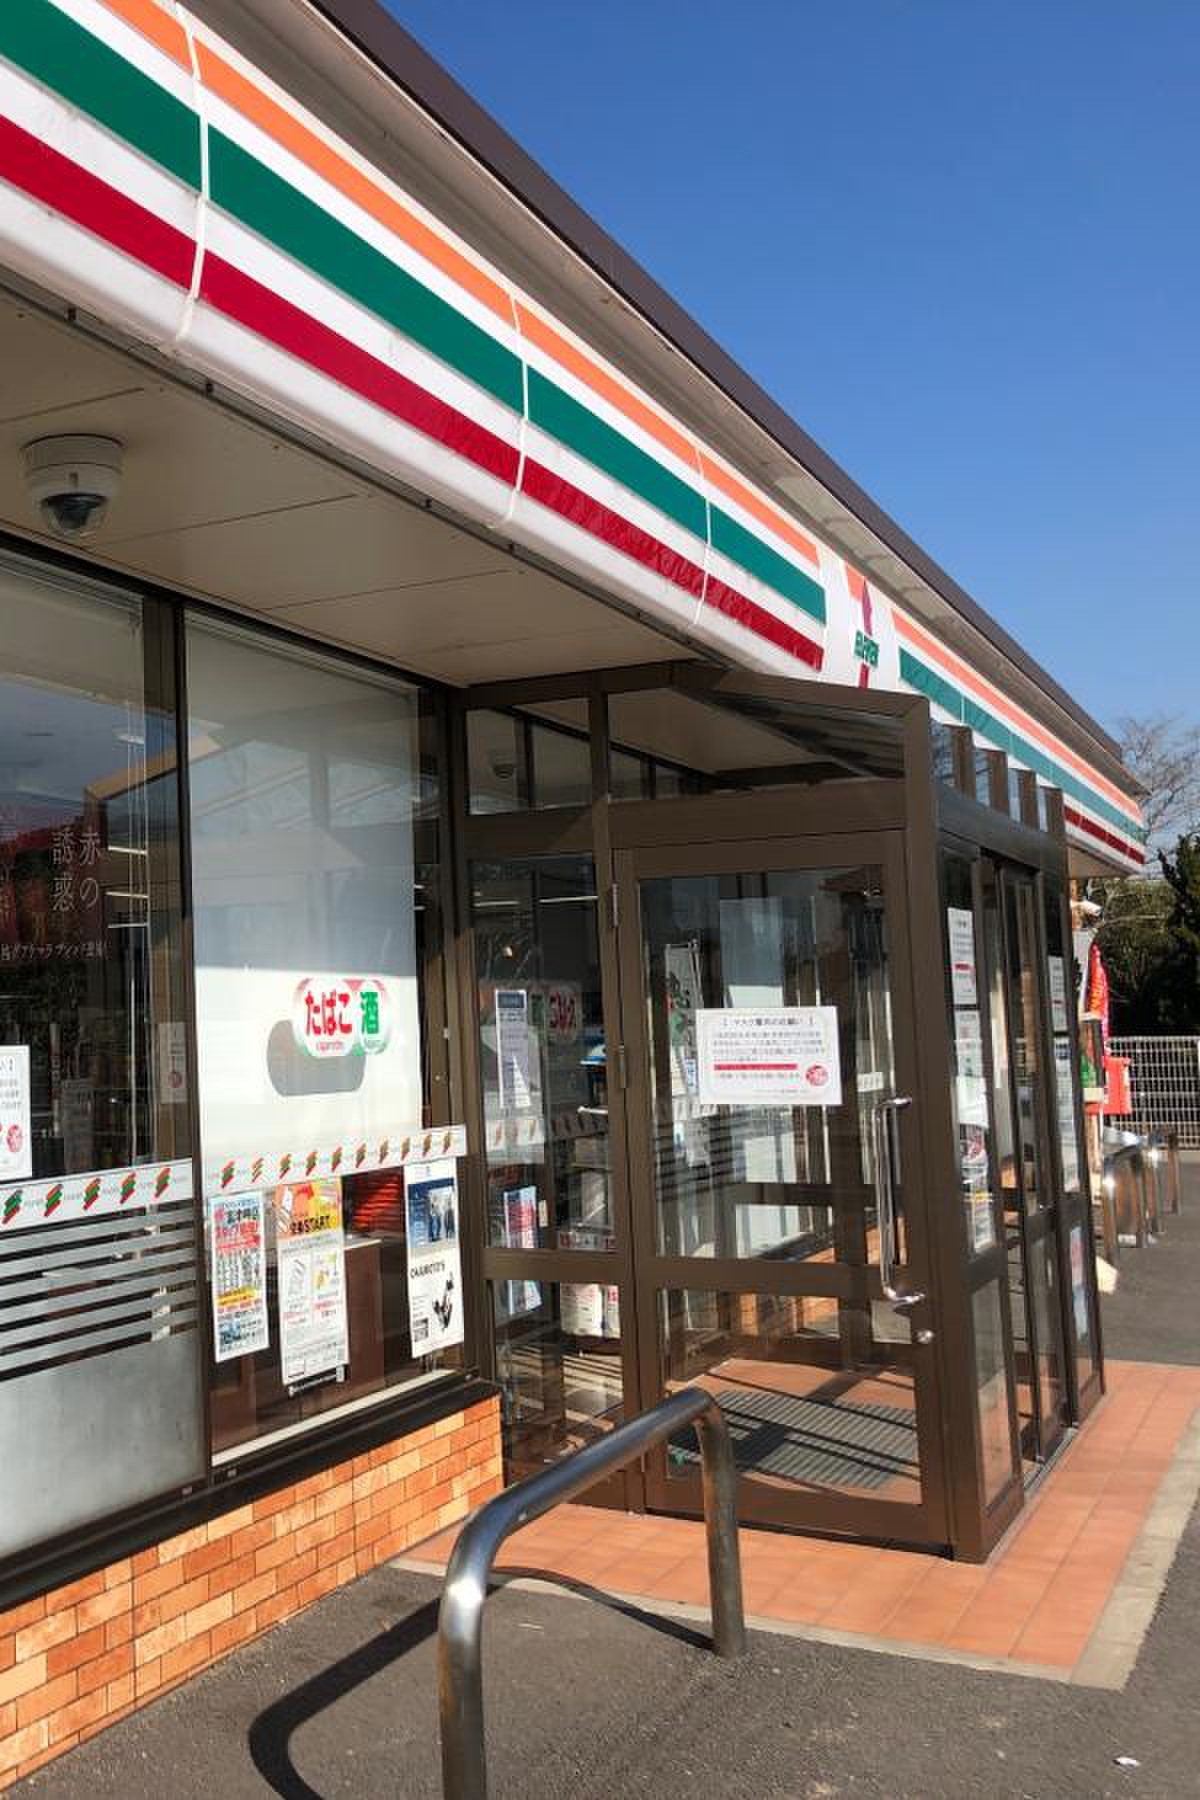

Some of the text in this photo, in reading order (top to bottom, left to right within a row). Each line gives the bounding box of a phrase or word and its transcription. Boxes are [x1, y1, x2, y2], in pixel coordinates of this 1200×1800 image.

[52, 829, 75, 912] 誘惑
[304, 989, 379, 1036] たばこ 酒
